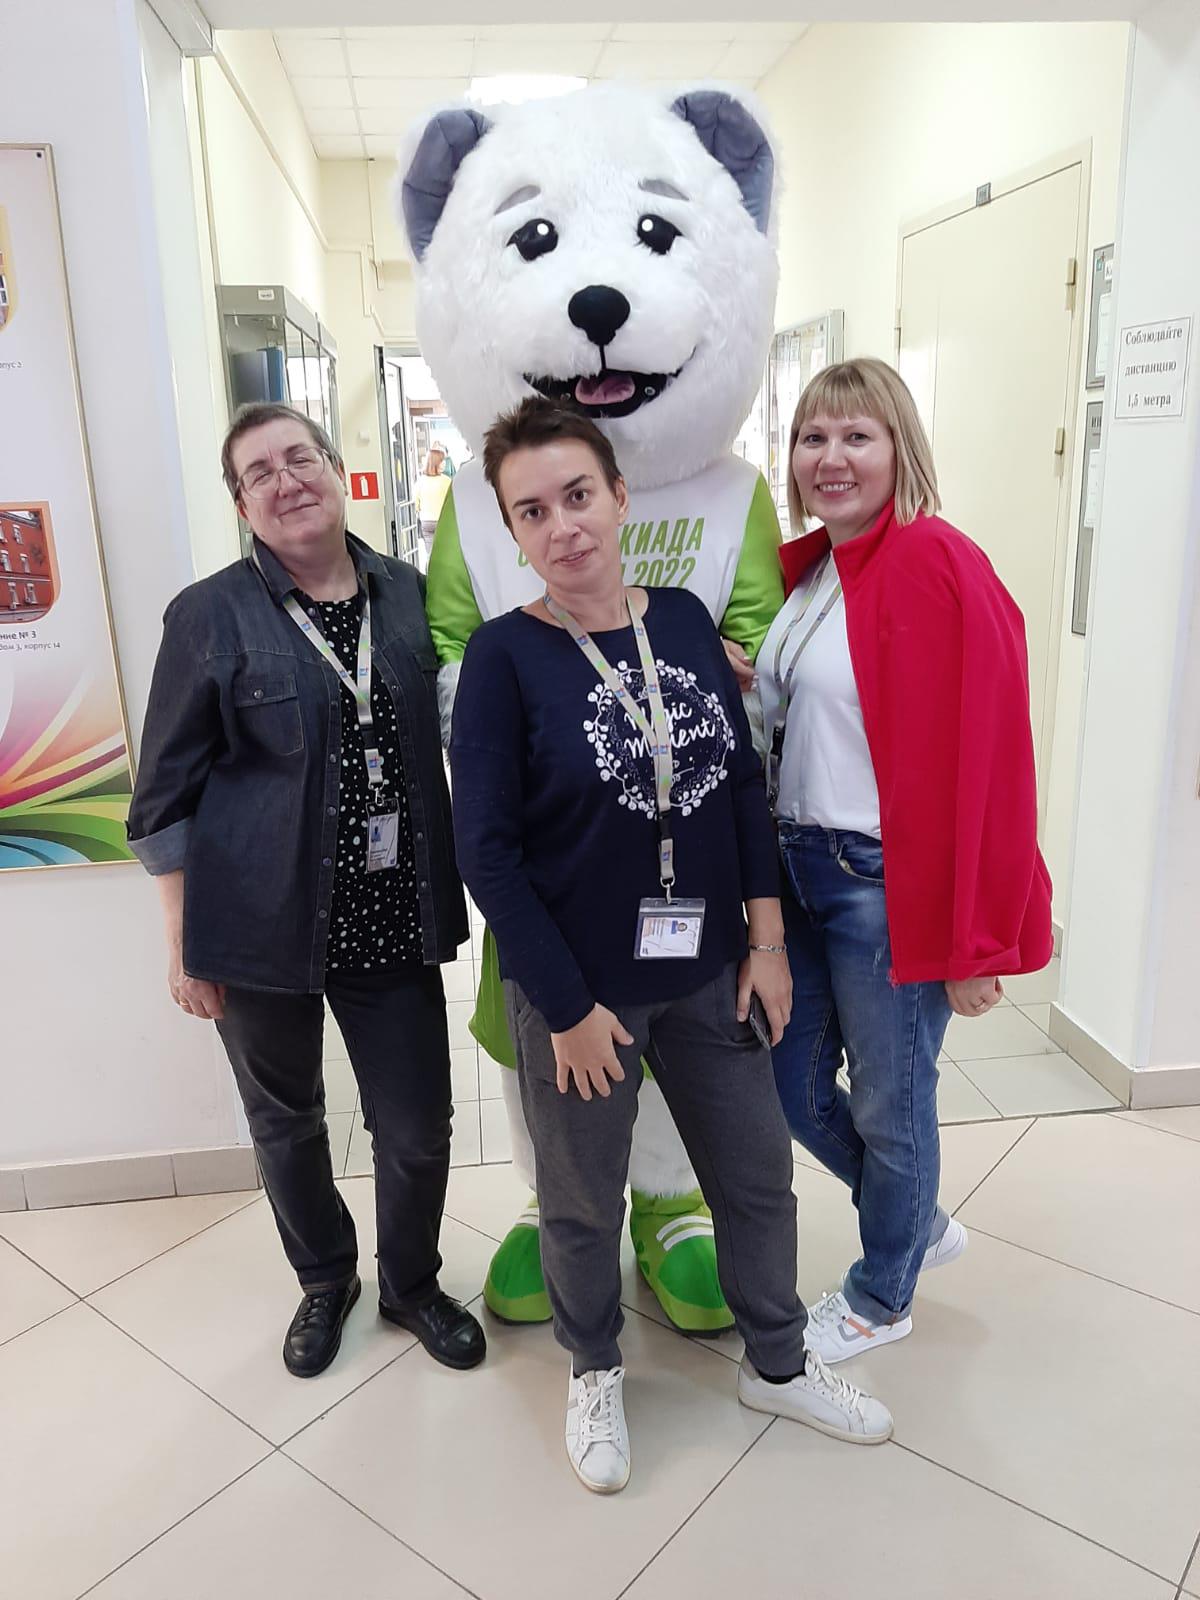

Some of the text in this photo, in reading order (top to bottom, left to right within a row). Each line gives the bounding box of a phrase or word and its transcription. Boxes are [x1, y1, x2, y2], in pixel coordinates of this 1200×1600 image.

[1125, 325, 1183, 346] Соблюдайте
[1124, 360, 1177, 377] дистанцию
[1127, 393, 1172, 408] 1,5 метра
[31, 630, 37, 639] 3
